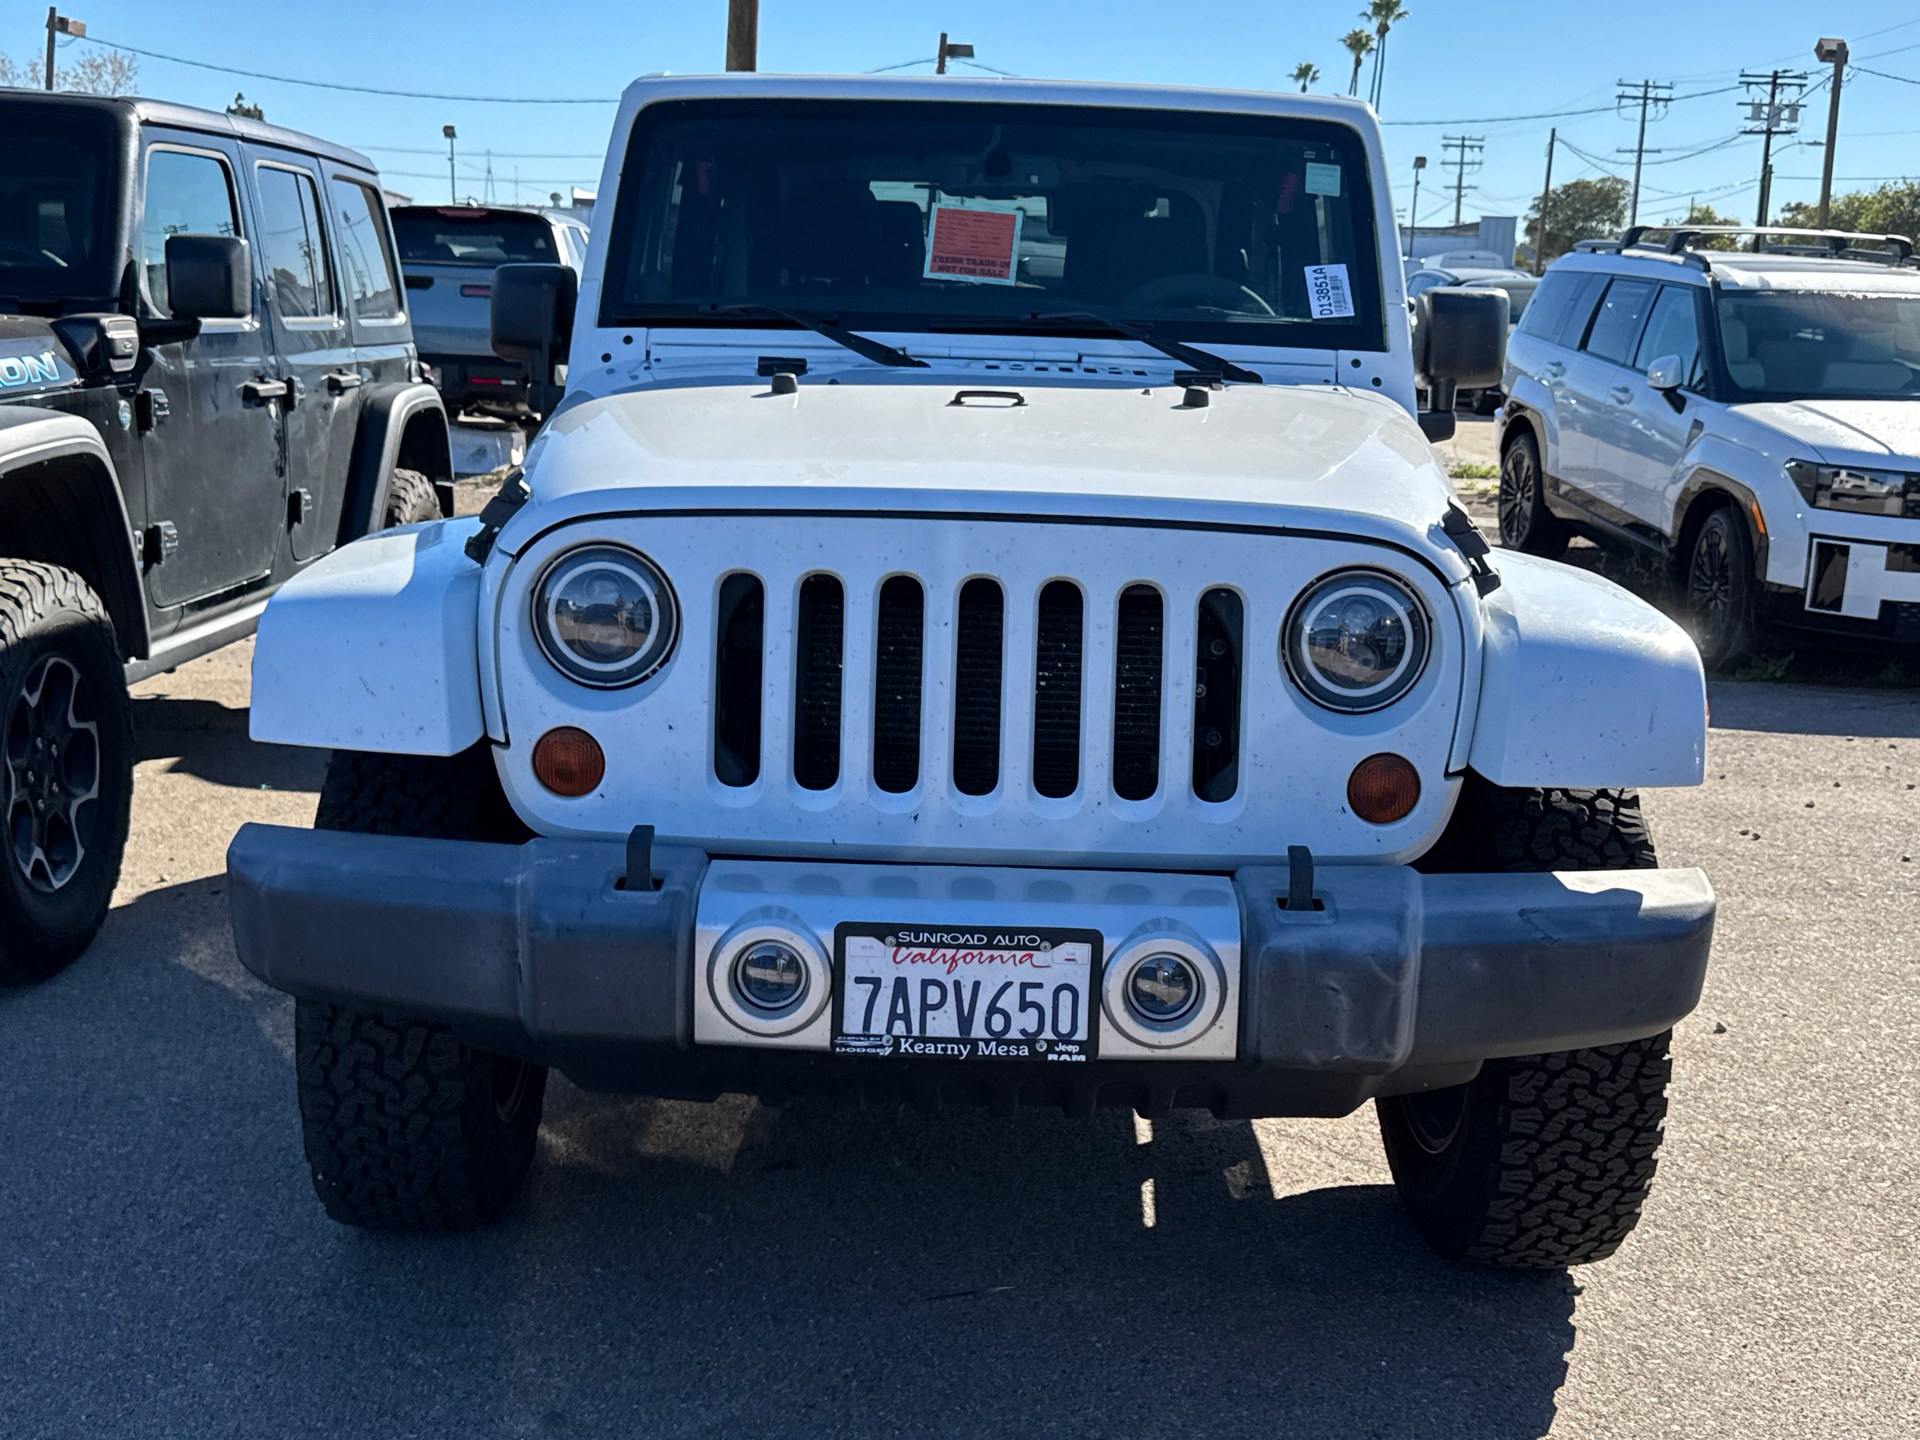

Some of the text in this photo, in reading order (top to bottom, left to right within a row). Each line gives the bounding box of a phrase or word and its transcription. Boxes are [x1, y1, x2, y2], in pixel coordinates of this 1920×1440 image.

[933, 255, 1011, 269] FRESH TRADE-IN
[937, 265, 1004, 277] NOT FOR SALE
[1312, 267, 1334, 316] D13851A
[0, 352, 60, 388] ON
[897, 931, 1041, 947] SUNROAD AUTO
[892, 945, 1052, 975] California
[853, 976, 1080, 1040] 7APV650
[899, 1038, 1029, 1060] Kearny Mesa
[1054, 1041, 1080, 1054] Jeep
[1047, 1053, 1087, 1062] RAM
